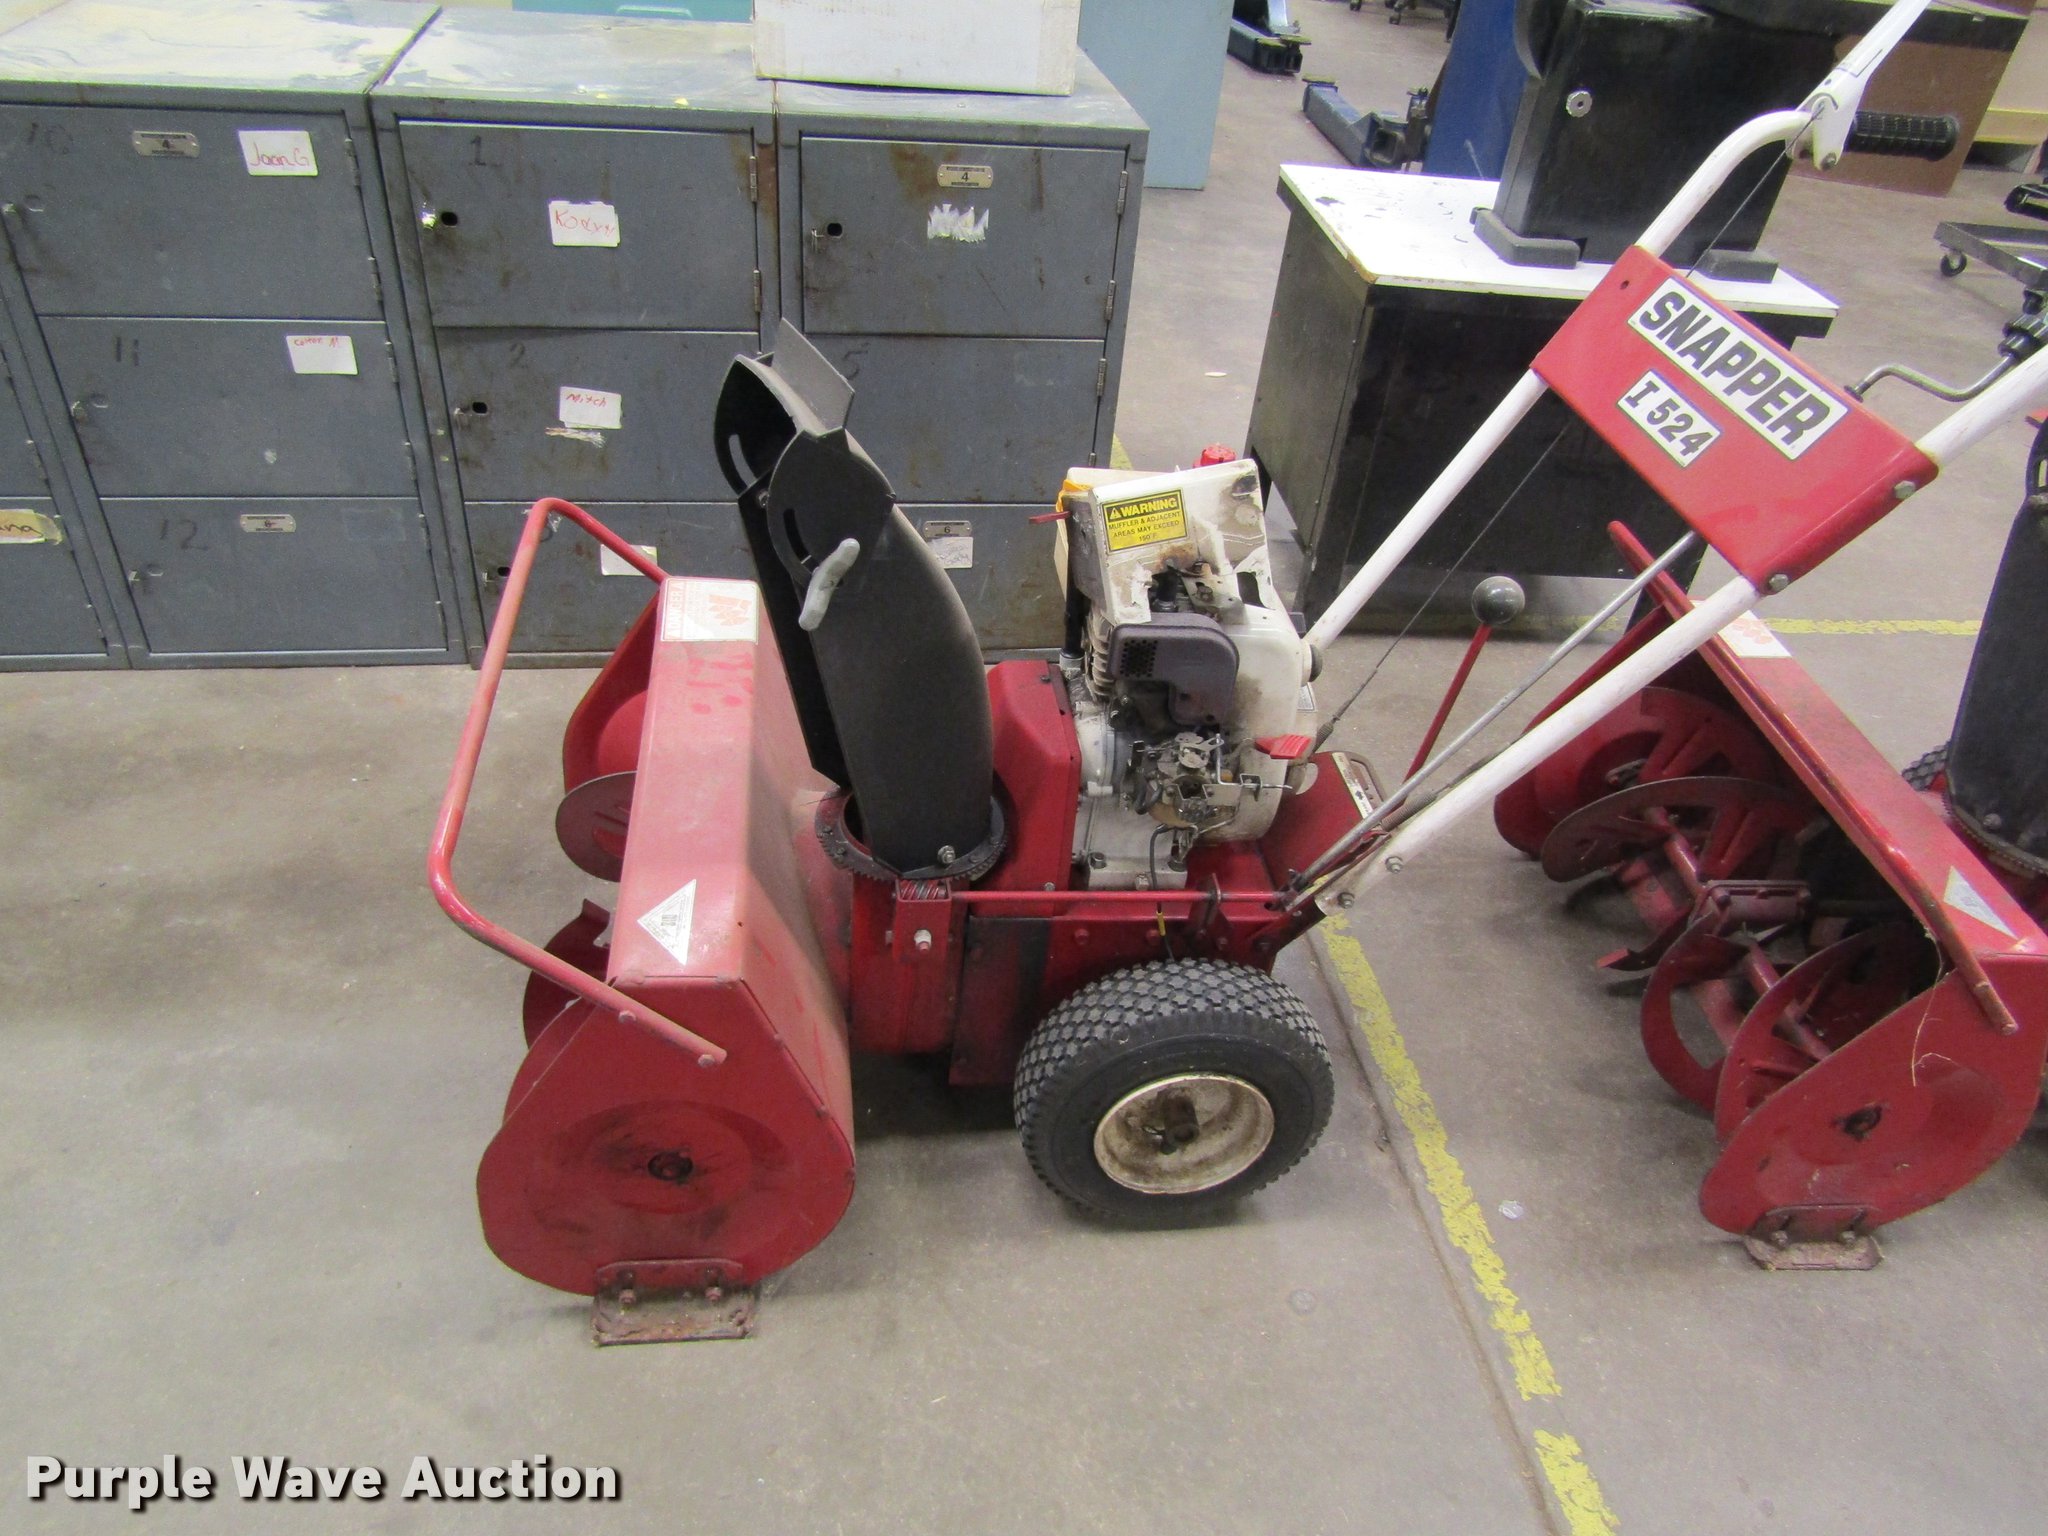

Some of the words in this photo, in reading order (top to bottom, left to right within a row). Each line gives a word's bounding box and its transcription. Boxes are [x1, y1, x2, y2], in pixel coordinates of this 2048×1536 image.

[961, 172, 969, 182] 4
[1639, 291, 1831, 446] SNAPPER
[1646, 398, 1714, 457] 524
[1120, 498, 1177, 516] WARNING
[1108, 519, 1138, 529] MUFFLER
[1146, 511, 1180, 522] ADJACENT
[1113, 530, 1135, 538] AREAS
[1137, 525, 1151, 533] MAY
[1153, 520, 1179, 529] EXCEED
[944, 525, 951, 534] 6
